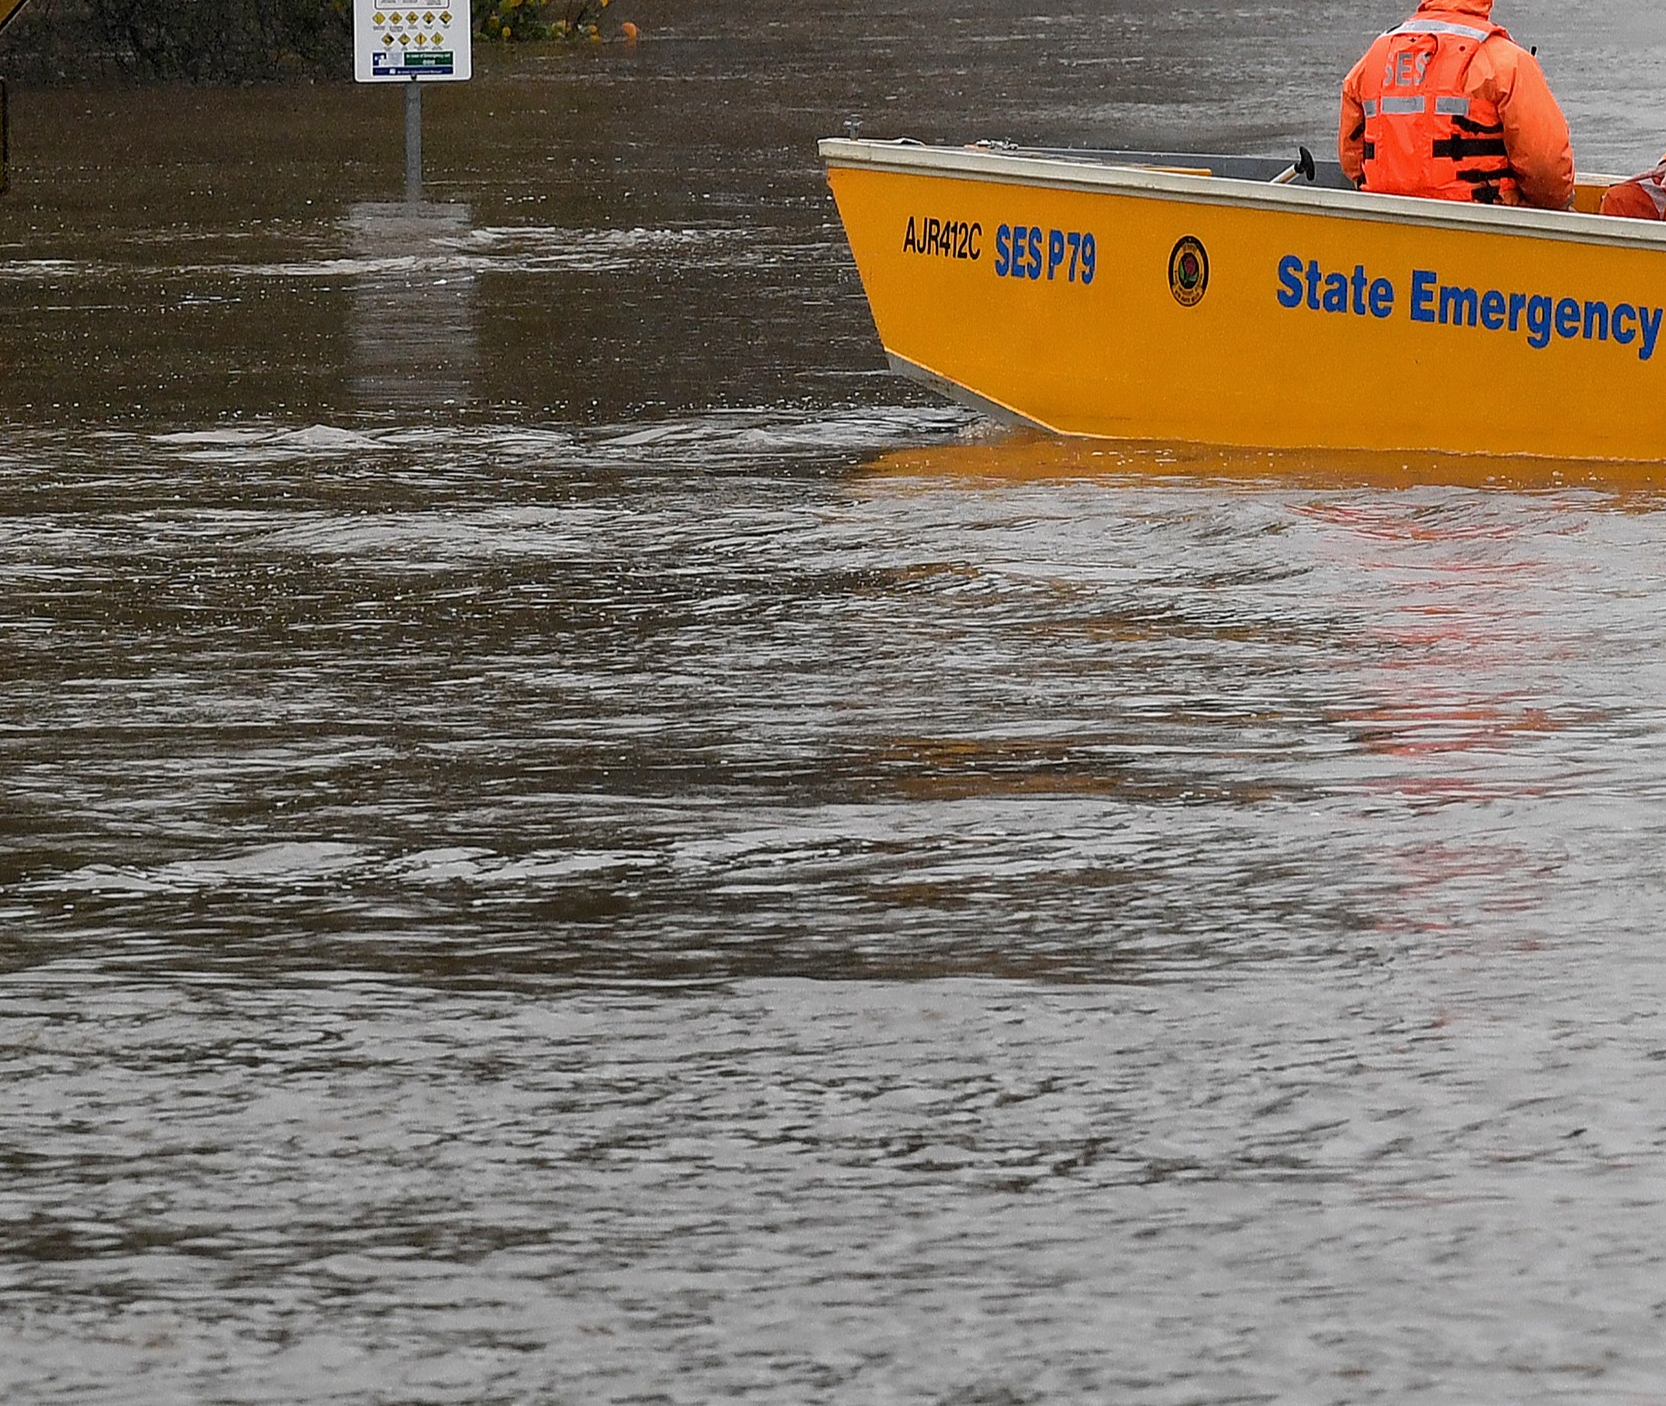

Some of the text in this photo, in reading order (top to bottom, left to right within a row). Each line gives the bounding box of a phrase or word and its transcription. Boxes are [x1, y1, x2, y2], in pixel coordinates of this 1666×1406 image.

[903, 216, 983, 260] AJR412C
[995, 224, 1096, 285] SES P79
[1277, 254, 1395, 319] State
[1410, 269, 1664, 360] Emergency
